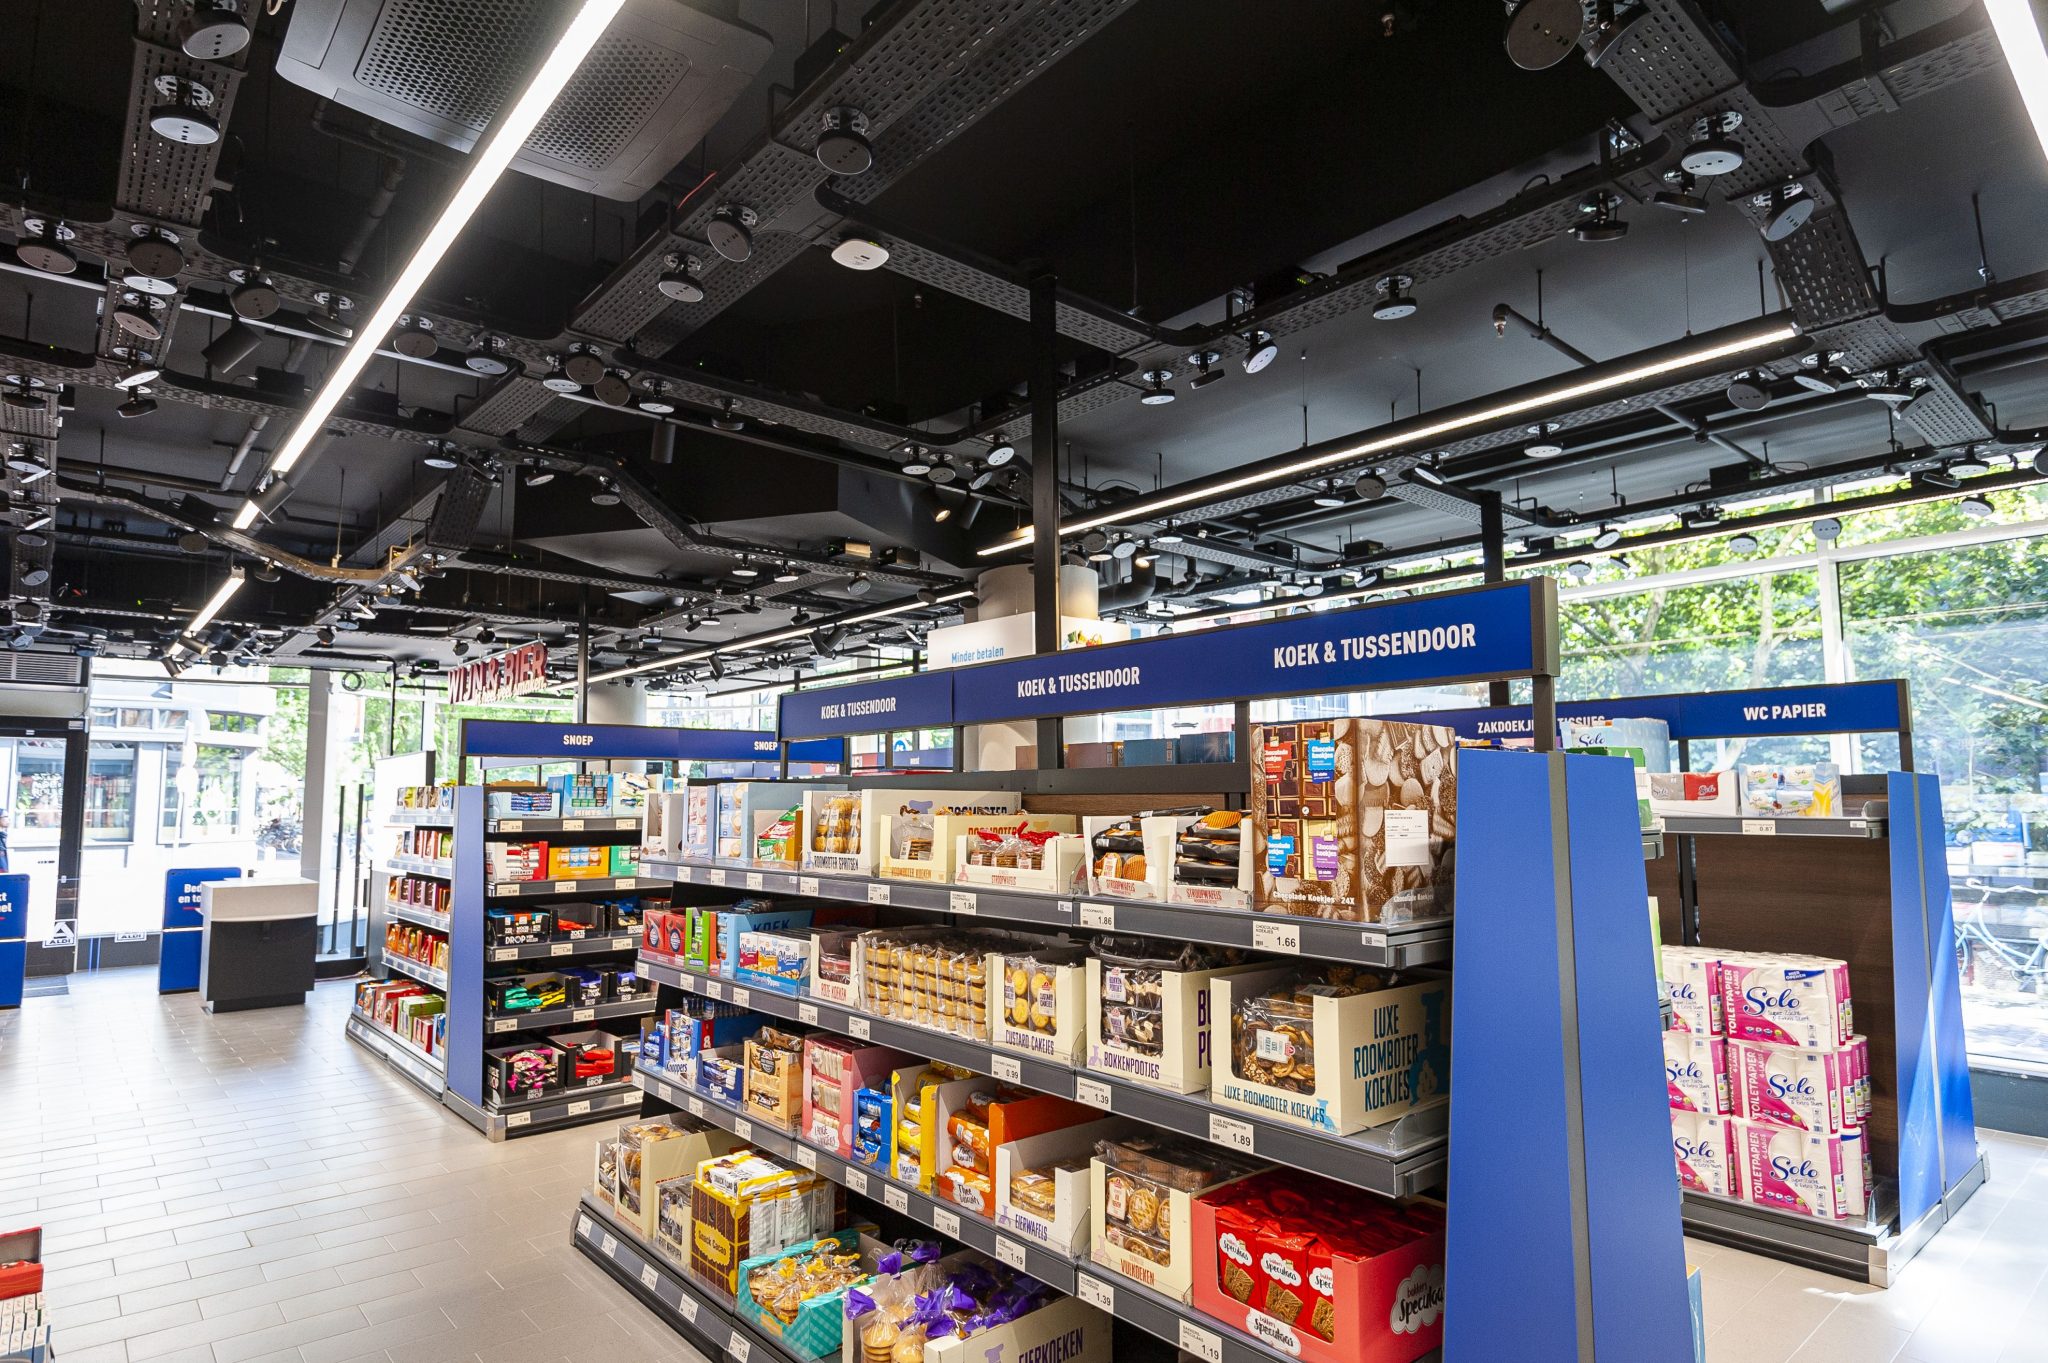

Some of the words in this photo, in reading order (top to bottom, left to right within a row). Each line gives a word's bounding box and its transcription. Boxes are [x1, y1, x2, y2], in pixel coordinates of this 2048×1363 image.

[951, 651, 975, 664] Minder
[976, 646, 1004, 660] betalen
[1274, 642, 1319, 669] KOEK
[1323, 641, 1337, 664] &
[1341, 623, 1476, 661] TUSSENDOOR
[447, 662, 486, 705] WIJN
[486, 657, 500, 691] &
[504, 643, 548, 688] BIER
[1017, 678, 1046, 698] KOEK
[1048, 677, 1056, 694] &
[1059, 666, 1140, 693] TUSSENDOOR
[821, 703, 839, 720] KOEK
[840, 703, 846, 718] &
[847, 697, 896, 718] TUSSENDOOR
[1743, 706, 1768, 721] WC
[1772, 703, 1826, 719] PAPIER
[1478, 719, 1535, 734] ZAKDOEKJ
[563, 734, 594, 746] SNOEP
[754, 741, 778, 751] SNOEP
[838, 857, 859, 871] SPRITSEN
[1106, 878, 1136, 893] STROOPWAFELS
[1186, 887, 1222, 901] STROOPWAFELS
[178, 895, 191, 904] en
[963, 902, 975, 911] 1.84
[1272, 890, 1307, 901] Chocolade
[1308, 894, 1335, 904] Koekjes
[1341, 897, 1355, 905] 24X
[1098, 916, 1112, 926] 1.86
[505, 934, 526, 945] DROP
[1276, 936, 1296, 948] 1.66
[778, 950, 798, 962] Muesli
[1665, 982, 1697, 999] olo
[1724, 968, 1738, 1035] TOILETPAPIER
[1743, 986, 1800, 1016] Solo
[1373, 1004, 1399, 1039] LUXE
[1005, 1029, 1029, 1048] CUSTARD
[1031, 1036, 1054, 1056] CAKEJES
[1104, 1051, 1160, 1080] BOKKENPOOTJES
[1353, 1033, 1419, 1080] ROOMBOTER
[666, 1061, 688, 1075] Knoppers
[1006, 1069, 1019, 1079] 0.99
[1666, 1059, 1703, 1082] Solo
[1364, 1069, 1410, 1112] KOEKJES
[1747, 1051, 1761, 1120] TOILETPAPIER
[1766, 1073, 1815, 1099] Solo
[1094, 1093, 1109, 1105] 1.39
[1224, 1084, 1241, 1101] LUXE
[1243, 1089, 1288, 1114] ROOMBOTER
[1291, 1101, 1325, 1124] KOEKJES
[1232, 1132, 1251, 1147] 1.89
[1674, 1137, 1715, 1160] Solo
[1750, 1131, 1764, 1200] TOILETPAPIER
[1770, 1155, 1818, 1182] Solo
[957, 1184, 972, 1196] Thee
[895, 1199, 907, 1210] 0.75
[1015, 1213, 1048, 1242] EIERWAFELS
[1010, 1252, 1023, 1265] 1.19
[1223, 1241, 1249, 1262] Speculaas
[1120, 1258, 1155, 1287] VULKOEKEN
[1265, 1260, 1297, 1282] Speculaas
[1315, 1275, 1333, 1288] Spec
[1096, 1292, 1111, 1306] 1.39
[1399, 1286, 1445, 1325] Speculaa
[1254, 1317, 1294, 1348] Speculaas
[1201, 1344, 1220, 1360] 1.19
